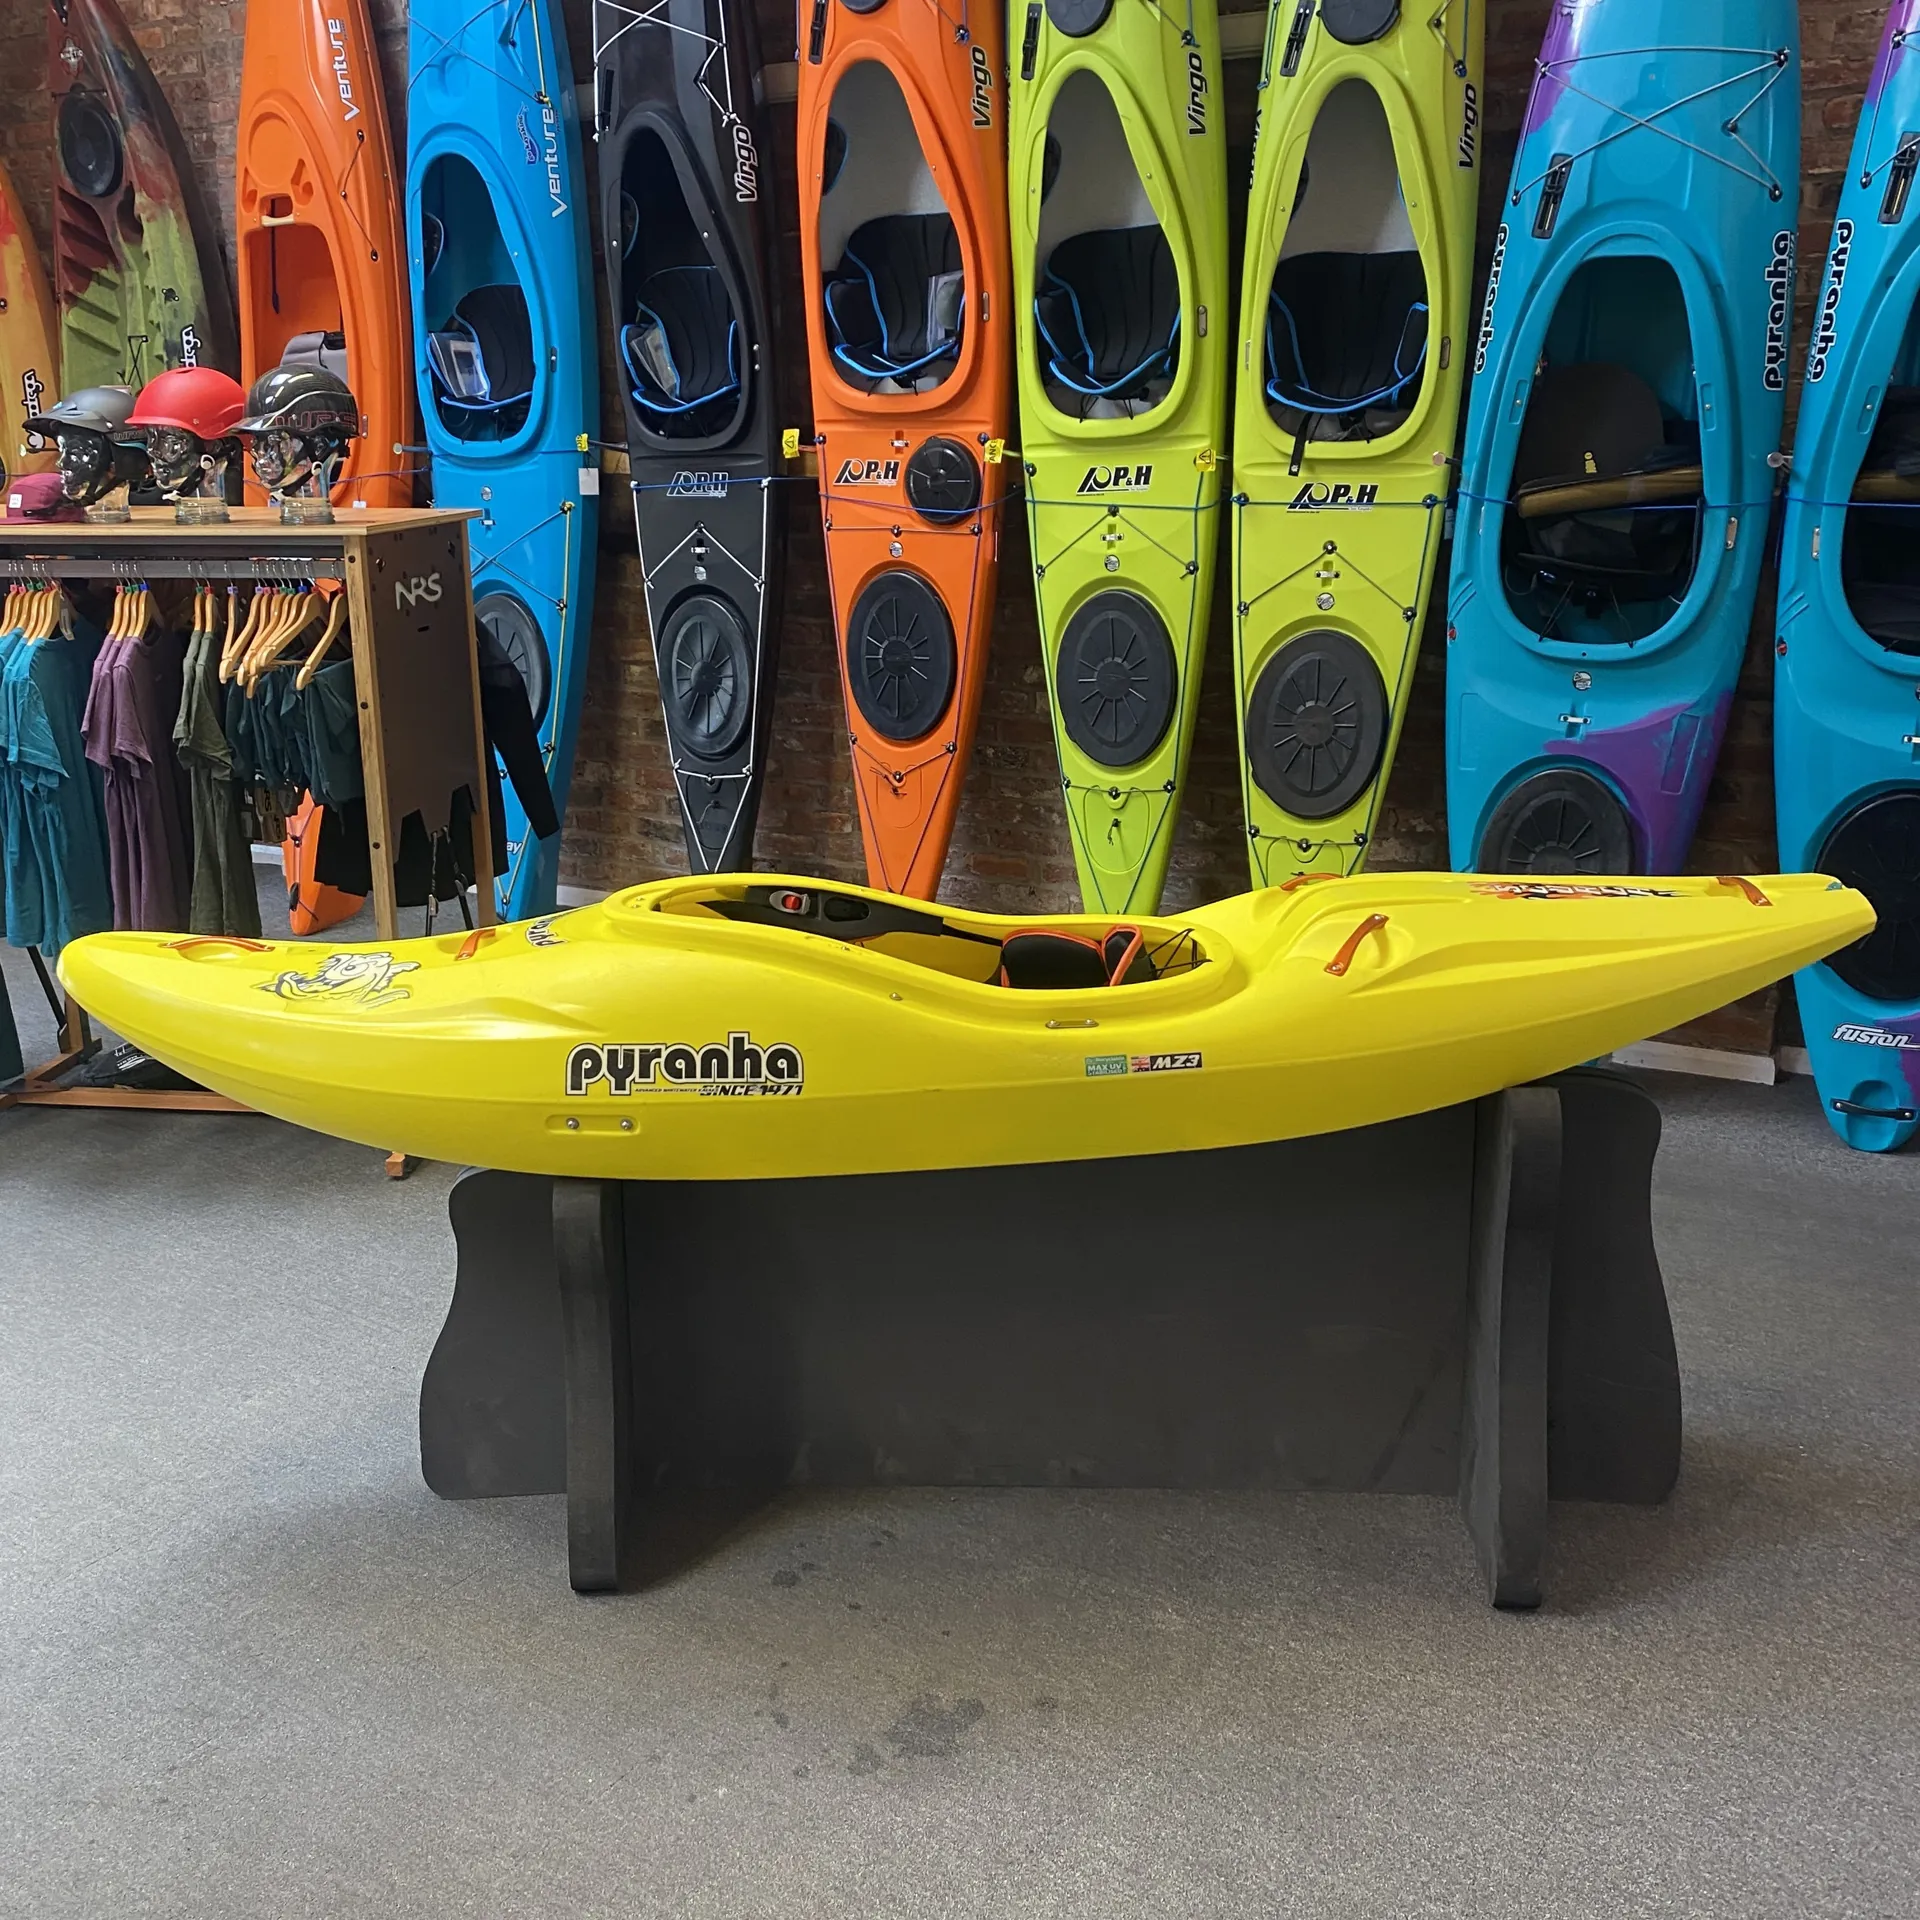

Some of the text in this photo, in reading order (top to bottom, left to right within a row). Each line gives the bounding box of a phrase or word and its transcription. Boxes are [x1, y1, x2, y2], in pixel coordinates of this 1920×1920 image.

[327, 18, 360, 121] Venture
[971, 45, 992, 129] Virgo
[1188, 51, 1208, 136] Virgo
[542, 108, 567, 218] Venture
[733, 124, 758, 202] Virgo
[1458, 82, 1479, 169] Virgo
[1474, 223, 1509, 374] pyranha
[1763, 230, 1791, 391] pyranha
[1810, 218, 1854, 383] pyranha
[863, 460, 899, 479] P&H
[1112, 465, 1153, 486] P&H
[1330, 484, 1379, 505] P&H
[395, 572, 442, 610] NRS
[565, 1031, 804, 1096] pyranha
[1152, 1054, 1201, 1070] MZ3
[1832, 1024, 1912, 1048] fusion
